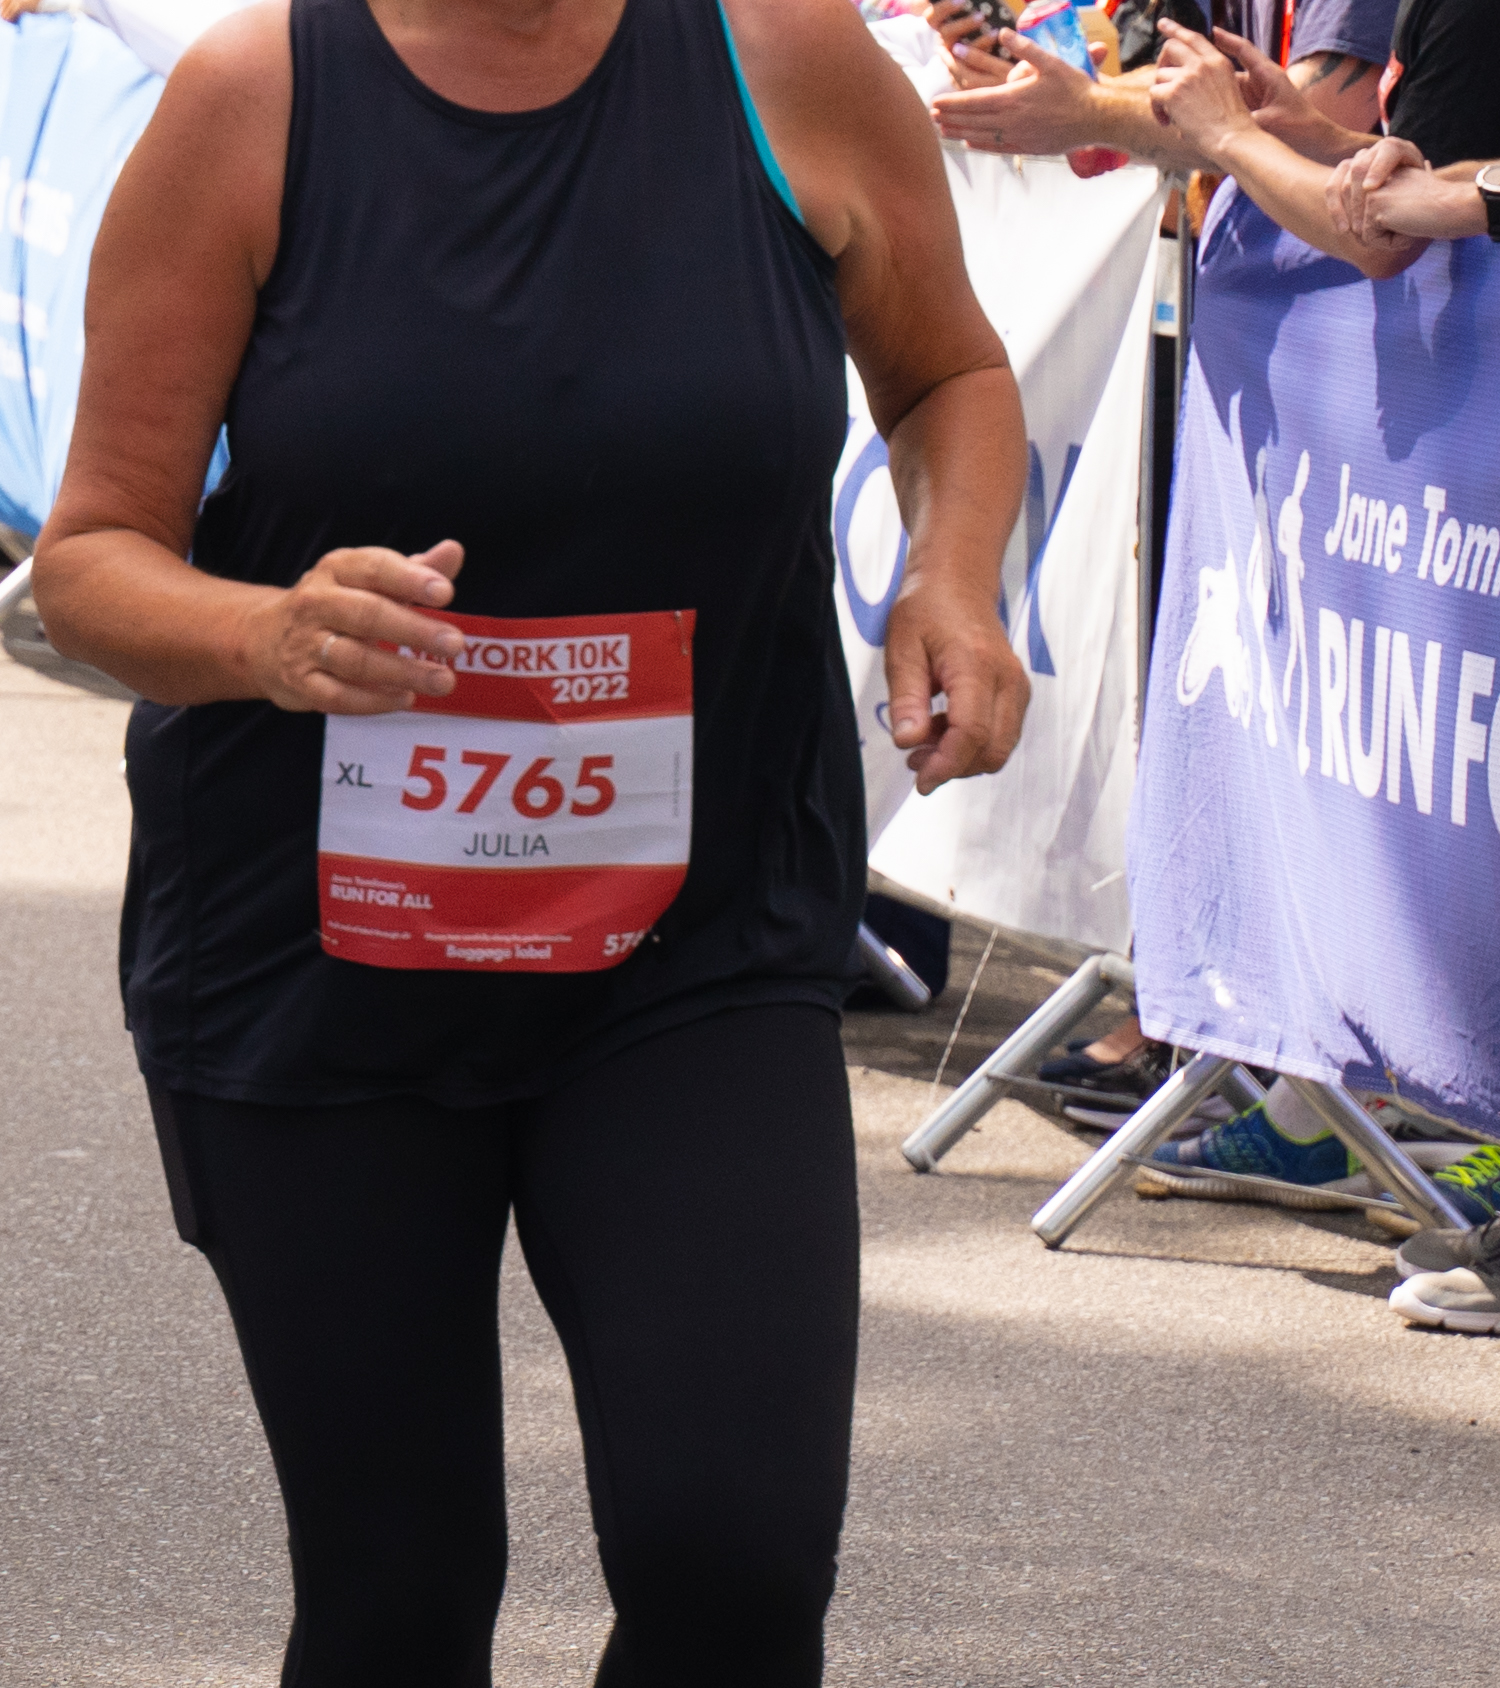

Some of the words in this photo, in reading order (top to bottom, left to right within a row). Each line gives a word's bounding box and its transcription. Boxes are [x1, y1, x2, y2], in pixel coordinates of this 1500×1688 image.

[1324, 463, 1408, 574] Jane
[462, 642, 561, 672] YORK
[566, 640, 625, 669] 10K
[551, 675, 629, 704] 2022
[1319, 607, 1442, 815] RUN
[336, 761, 373, 789] XL
[401, 744, 617, 820] 5765
[463, 832, 550, 857] JULIA
[329, 883, 365, 903] RUN
[367, 888, 400, 908] FOR
[402, 893, 434, 910] ALL
